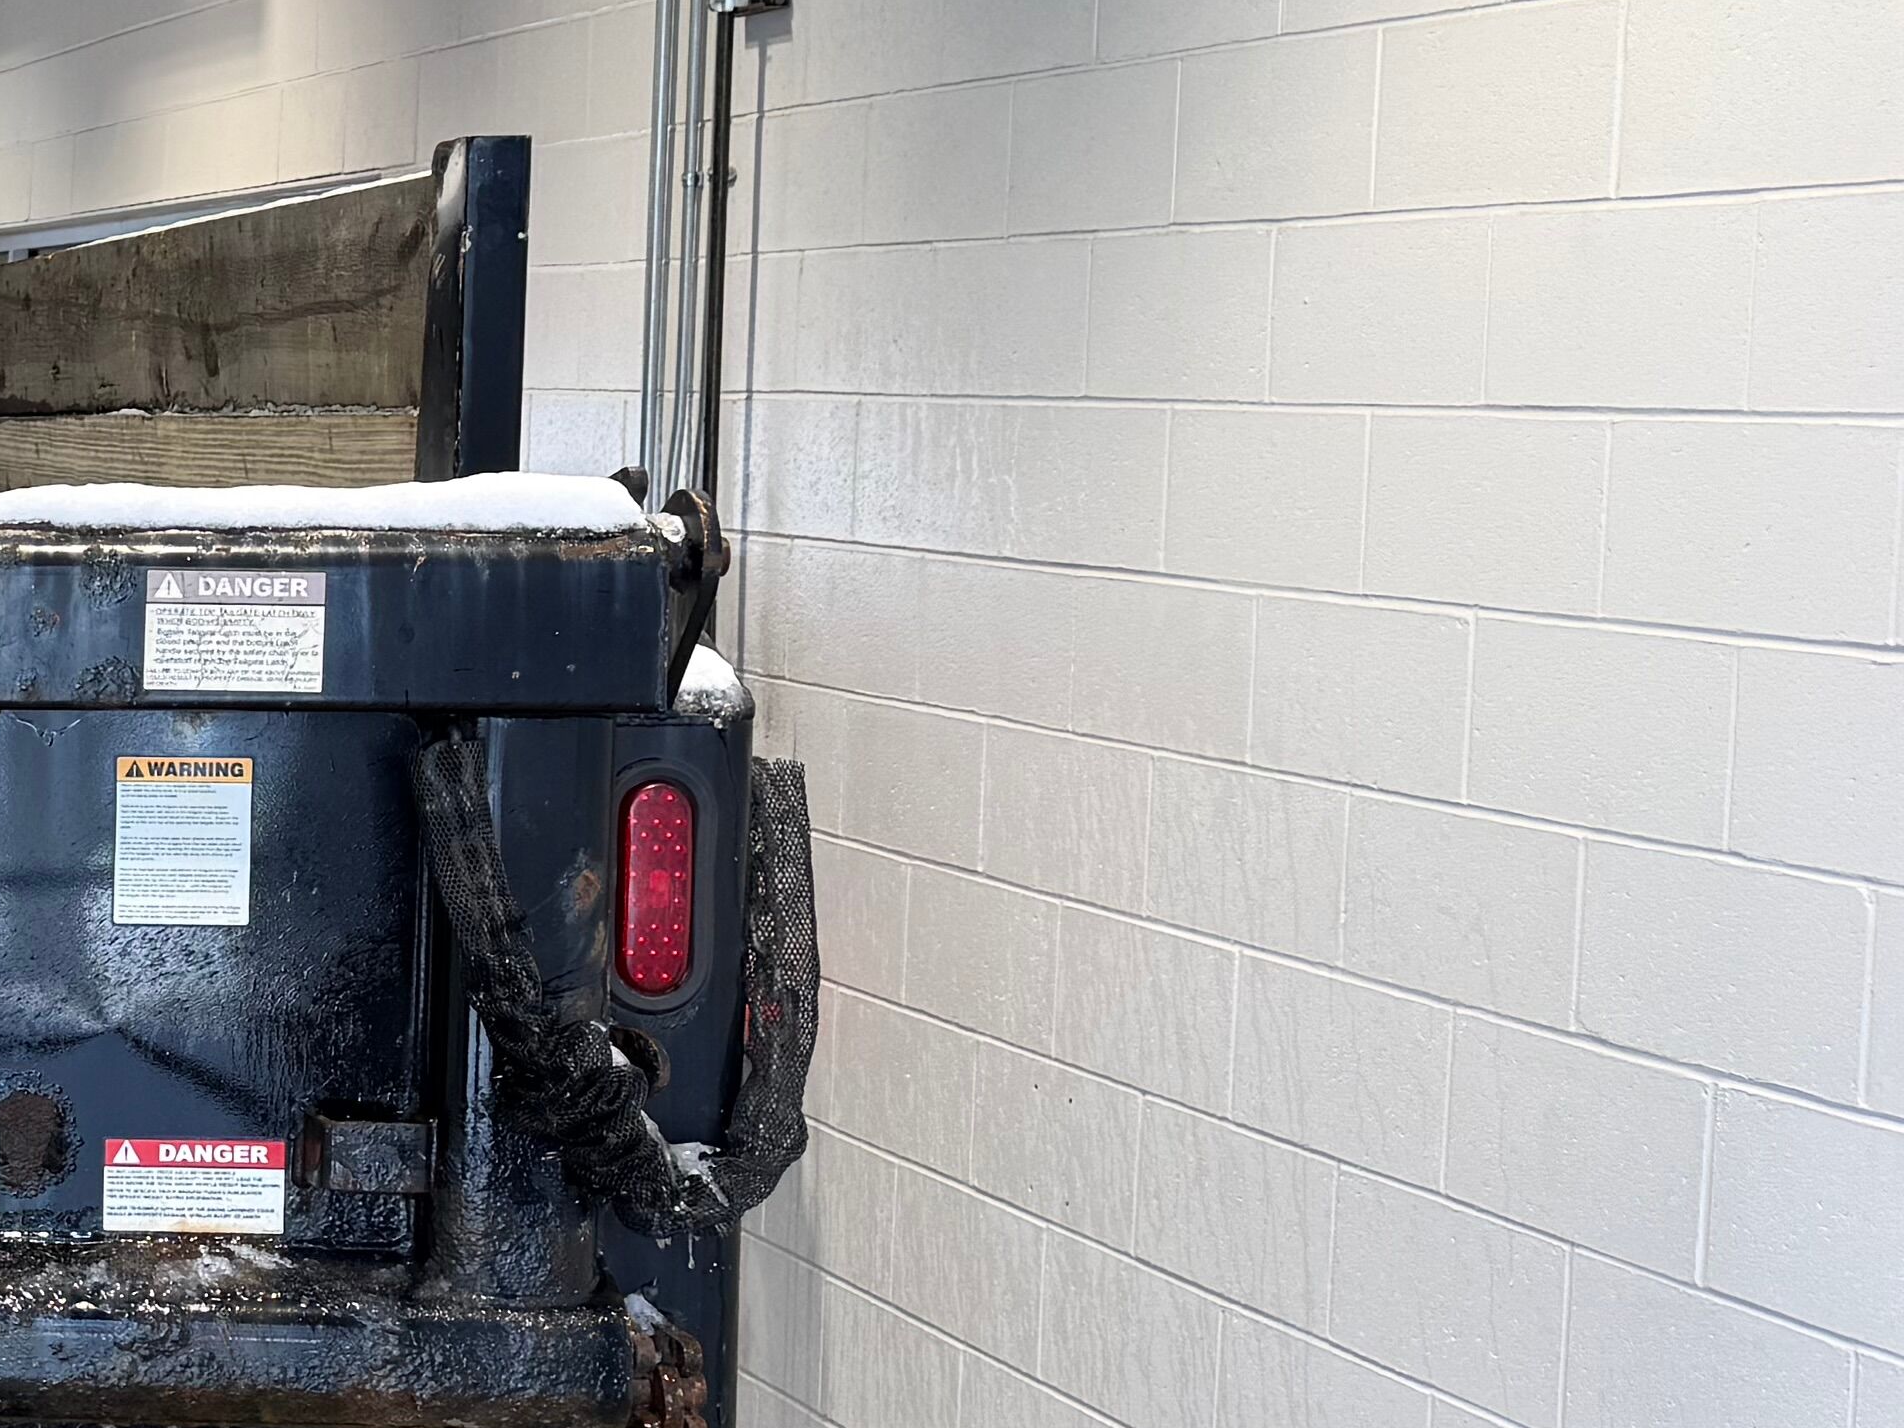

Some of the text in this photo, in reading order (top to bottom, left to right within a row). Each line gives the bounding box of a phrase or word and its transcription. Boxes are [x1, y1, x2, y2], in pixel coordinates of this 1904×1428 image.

[198, 577, 308, 598] DANGER
[147, 761, 245, 778] WARNING
[158, 1143, 269, 1164] DANGER
